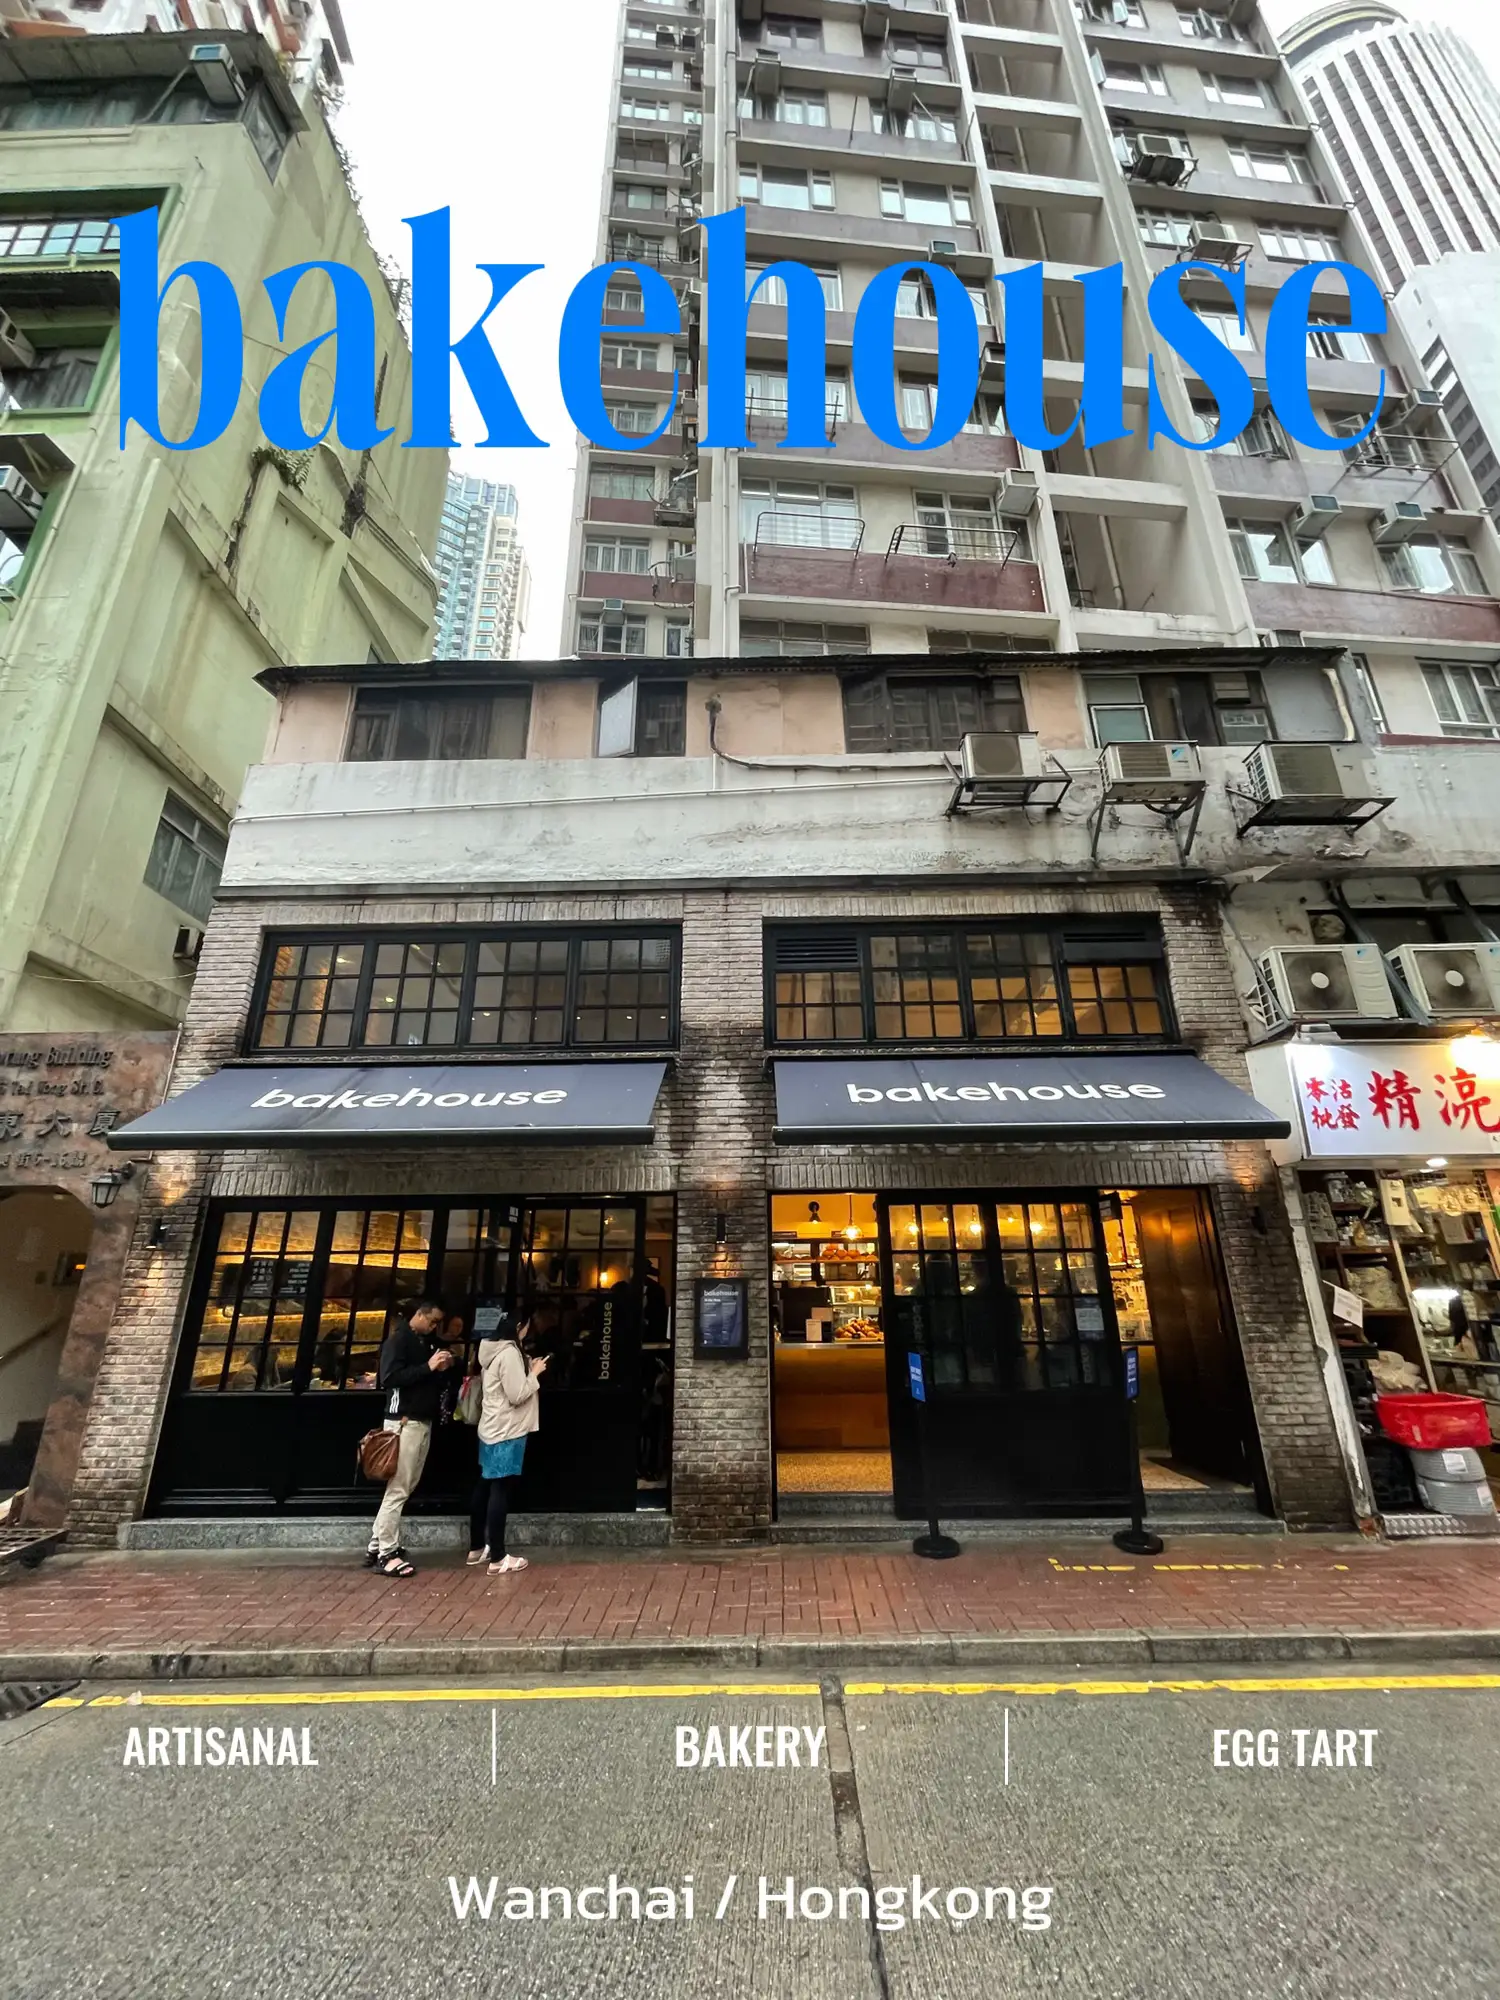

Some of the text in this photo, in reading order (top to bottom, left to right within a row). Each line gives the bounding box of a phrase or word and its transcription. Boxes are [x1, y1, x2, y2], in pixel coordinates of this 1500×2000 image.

[47, 1046, 114, 1068] Building
[250, 1088, 568, 1109] bakehouse
[846, 1082, 1166, 1103] bakehouse
[598, 1301, 613, 1380] bakehouse
